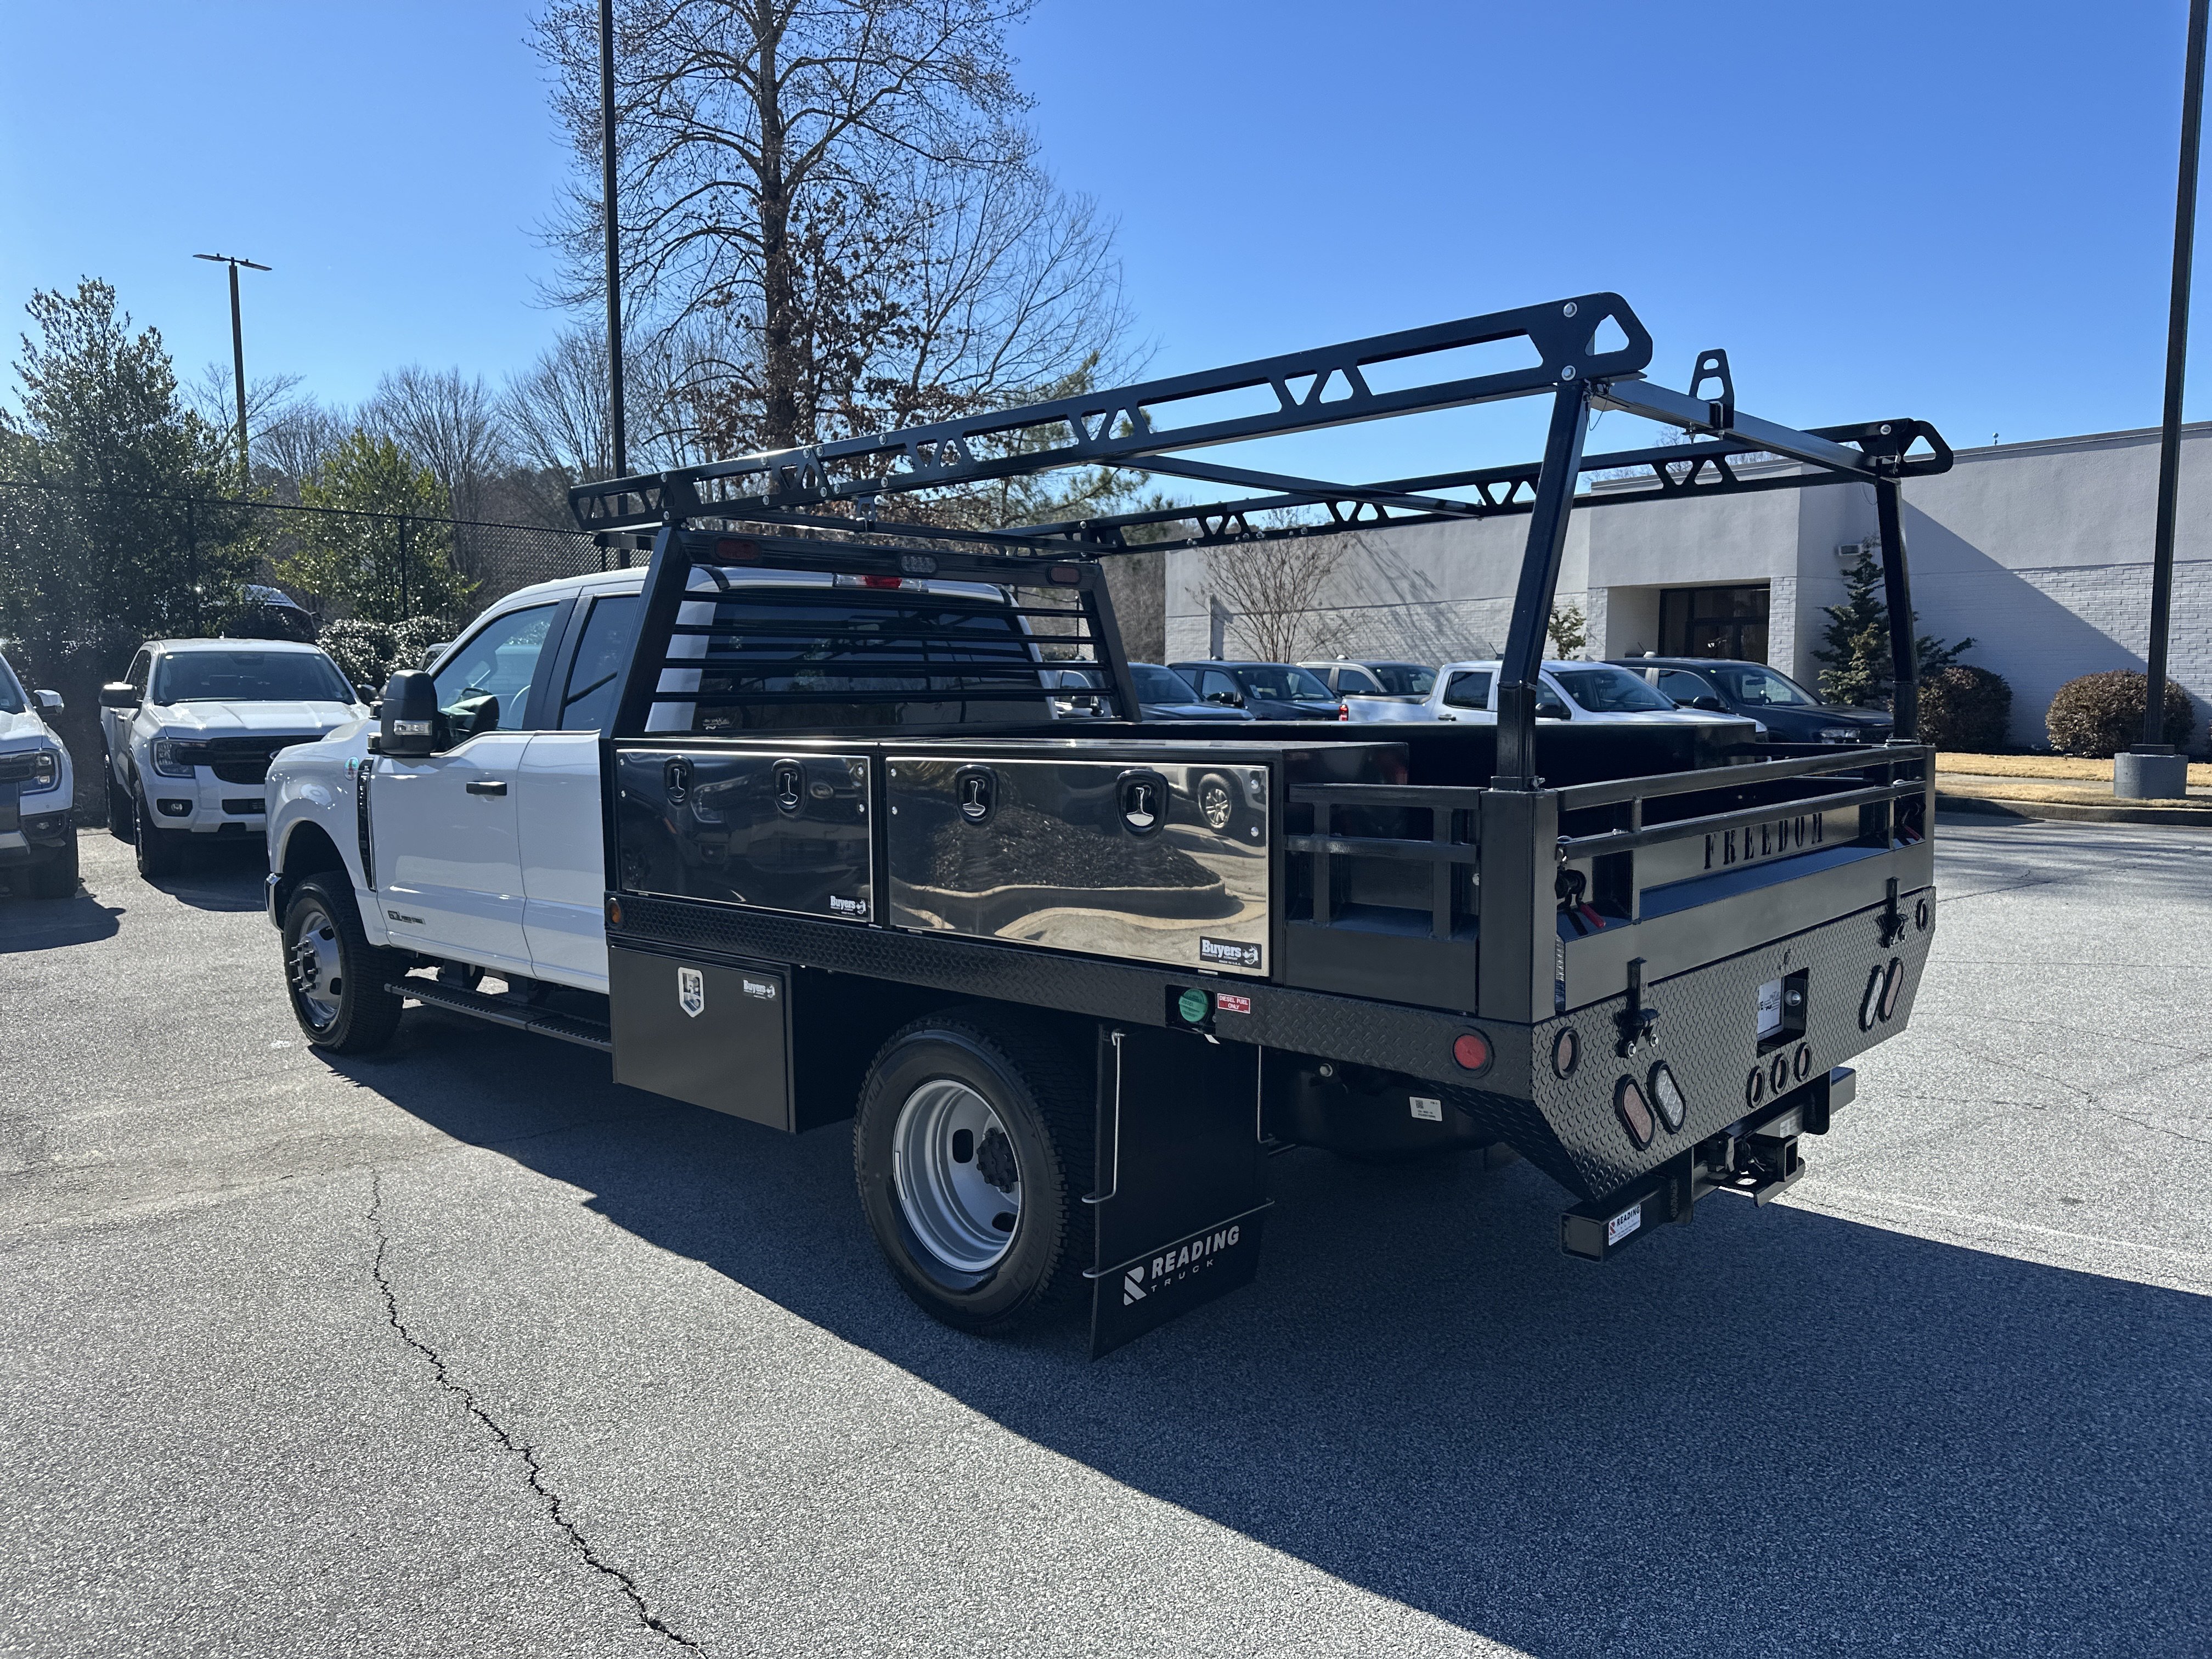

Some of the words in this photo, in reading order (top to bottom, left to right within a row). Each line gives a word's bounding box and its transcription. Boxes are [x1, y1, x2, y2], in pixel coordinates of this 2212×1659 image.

[1704, 812, 1822, 869] FREEDOM
[830, 895, 856, 910] Buyers
[1202, 939, 1242, 958] Buyers
[743, 979, 766, 994] Buyers
[1219, 995, 1235, 1003] DIESEL
[1617, 1206, 1640, 1227] READING
[1152, 1226, 1239, 1279] READING
[1151, 1259, 1214, 1292] TRUCK
